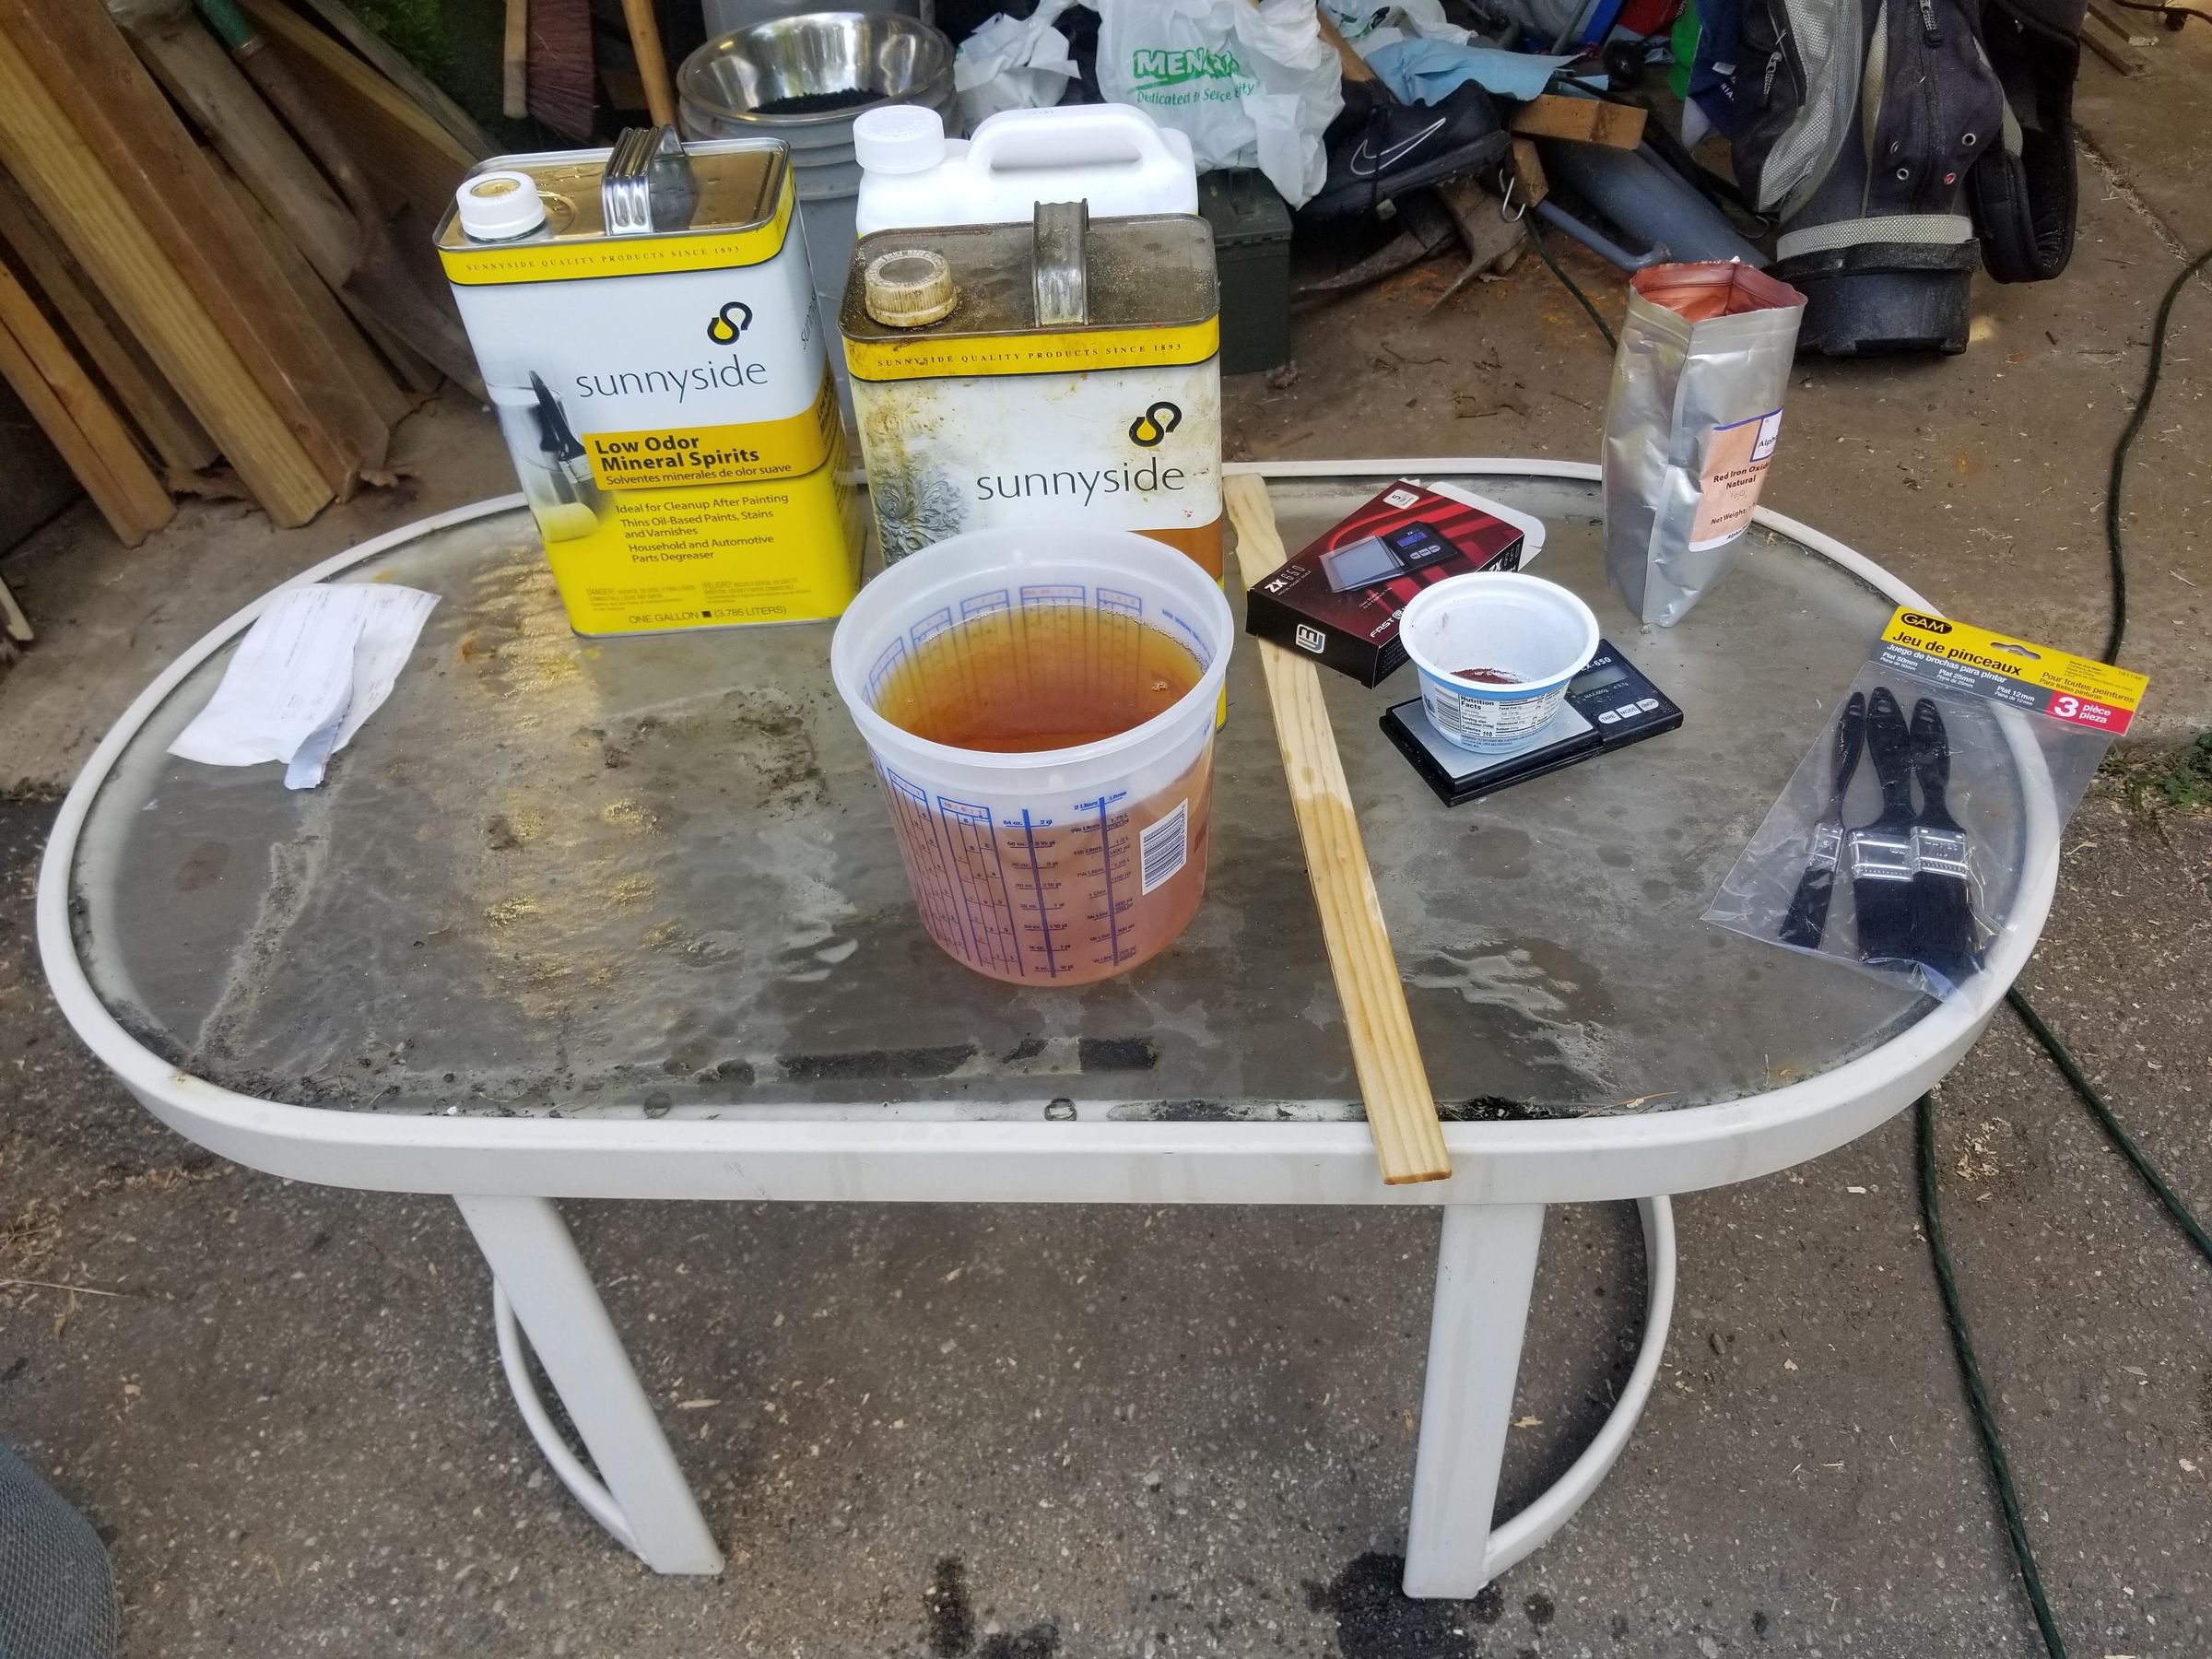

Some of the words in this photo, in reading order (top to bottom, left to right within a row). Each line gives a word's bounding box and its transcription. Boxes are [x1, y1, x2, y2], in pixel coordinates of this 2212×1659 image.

[1137, 91, 1190, 105] Dedicated
[465, 261, 535, 272] SUNNYSIDE
[541, 256, 594, 267] QUALITY
[602, 252, 665, 263] PRODUCTS
[671, 248, 708, 258] SINCE
[714, 245, 739, 254] 1893
[877, 355, 953, 367] SUNNYSIDE
[961, 352, 1022, 362] QUALITY
[1028, 348, 1099, 359] PRODUCTS
[1105, 345, 1147, 355] SINCE
[1153, 343, 1182, 351] 1893
[575, 353, 769, 404] sunnyside
[594, 440, 639, 455] Low
[644, 434, 700, 452] Odor
[601, 453, 684, 472] Mineral
[690, 448, 760, 469] Spirits
[606, 473, 661, 486] Solventes
[663, 469, 716, 482] minerales
[719, 467, 733, 478] de
[735, 466, 757, 477] olor
[759, 464, 792, 475] suave
[976, 457, 1185, 507] sunnyside
[1713, 473, 1729, 483] Red
[1730, 468, 1747, 478] Iron
[1725, 475, 1757, 489] Natural
[616, 503, 643, 513] Ideal
[645, 502, 661, 512] for
[664, 500, 710, 512] Cleanup
[712, 498, 740, 508] After
[742, 494, 789, 507] Painting
[620, 517, 650, 528] Thins
[652, 514, 702, 526] Oil-Based
[704, 512, 740, 523] Paints,
[741, 509, 774, 520] Stains
[1711, 516, 1723, 525] Net
[1724, 508, 1748, 521] Weight:
[624, 529, 645, 539] and
[646, 527, 698, 537] Varnishes
[629, 541, 686, 553] Household
[688, 539, 709, 549] and
[711, 535, 774, 547] Automotive
[631, 553, 659, 563] Parts
[661, 551, 714, 563] Degreaser
[1265, 579, 1288, 593] ZX
[1281, 565, 1305, 581] 650
[629, 614, 653, 624] ONE
[654, 611, 700, 622] GALLON
[746, 606, 787, 616] LITERS)
[1903, 614, 1946, 633] GAM
[1370, 617, 1394, 638] FAST
[1882, 651, 1896, 661] Plat
[1896, 656, 1918, 667] 50mm
[1892, 631, 1923, 647] Jeu
[1924, 641, 1945, 653] de
[1947, 648, 2022, 676] pinceaux
[1887, 643, 1912, 657] Juego
[1913, 651, 1927, 660] de
[1927, 654, 1959, 670] brochas
[1959, 664, 1981, 677] para
[1981, 670, 2008, 683] pintar
[1938, 668, 1953, 677] Plat
[1953, 673, 1976, 684] 25mm
[1997, 685, 2011, 695] Plat
[2012, 689, 2035, 702] 12mm
[2040, 677, 2054, 687] Para
[2056, 682, 2075, 692] todas
[2075, 688, 2102, 700] pinturas
[2041, 671, 2063, 683] Pour
[2065, 677, 2091, 690] toutes
[2092, 687, 2135, 703] peintures
[1460, 695, 1495, 706] Nutrition
[1461, 700, 1482, 710] Facts
[2053, 696, 2079, 717] 3
[2081, 703, 2112, 716] pièce
[1601, 713, 1617, 722] TARE
[1619, 706, 1639, 715] MODE
[2078, 712, 2108, 724] pieza
